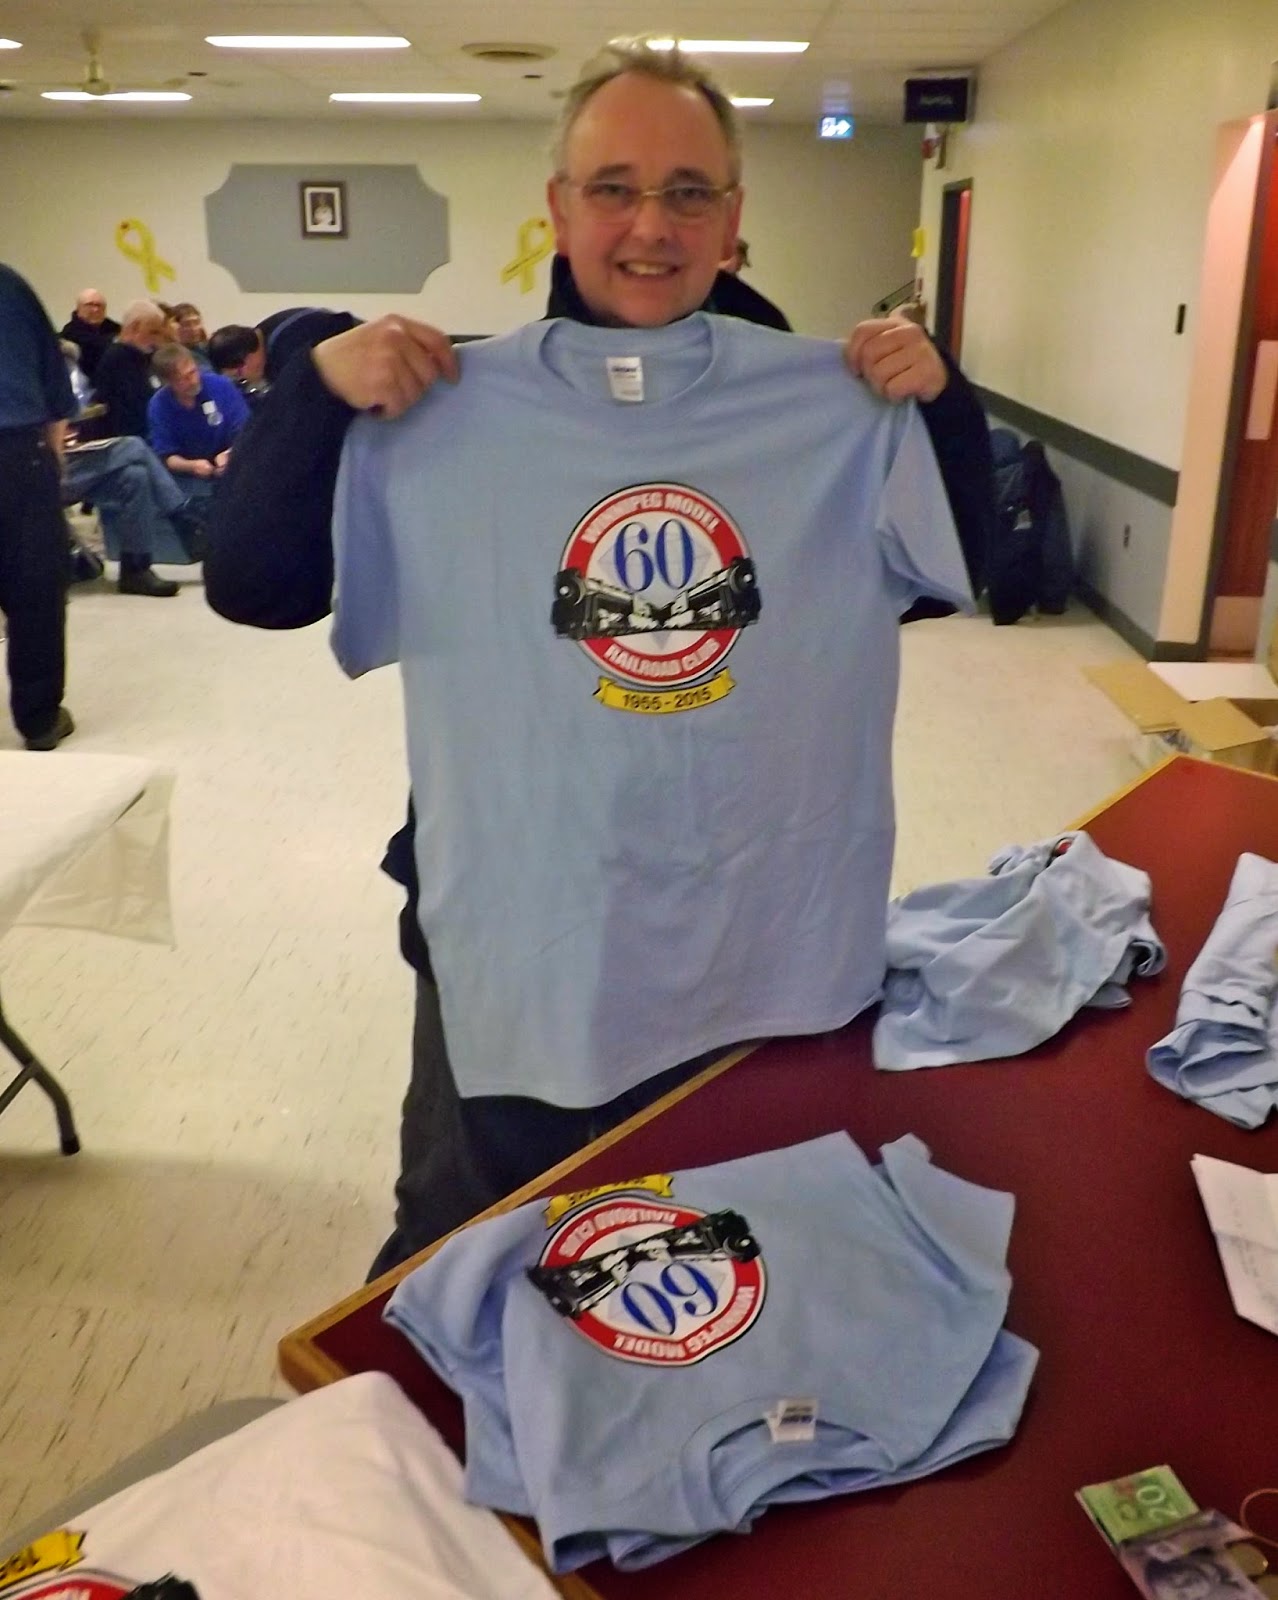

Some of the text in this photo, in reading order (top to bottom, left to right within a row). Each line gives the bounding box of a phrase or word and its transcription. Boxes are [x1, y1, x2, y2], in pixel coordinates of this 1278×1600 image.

[664, 492, 721, 533] MODEL
[613, 518, 695, 593] 60
[621, 1262, 718, 1336] 60
